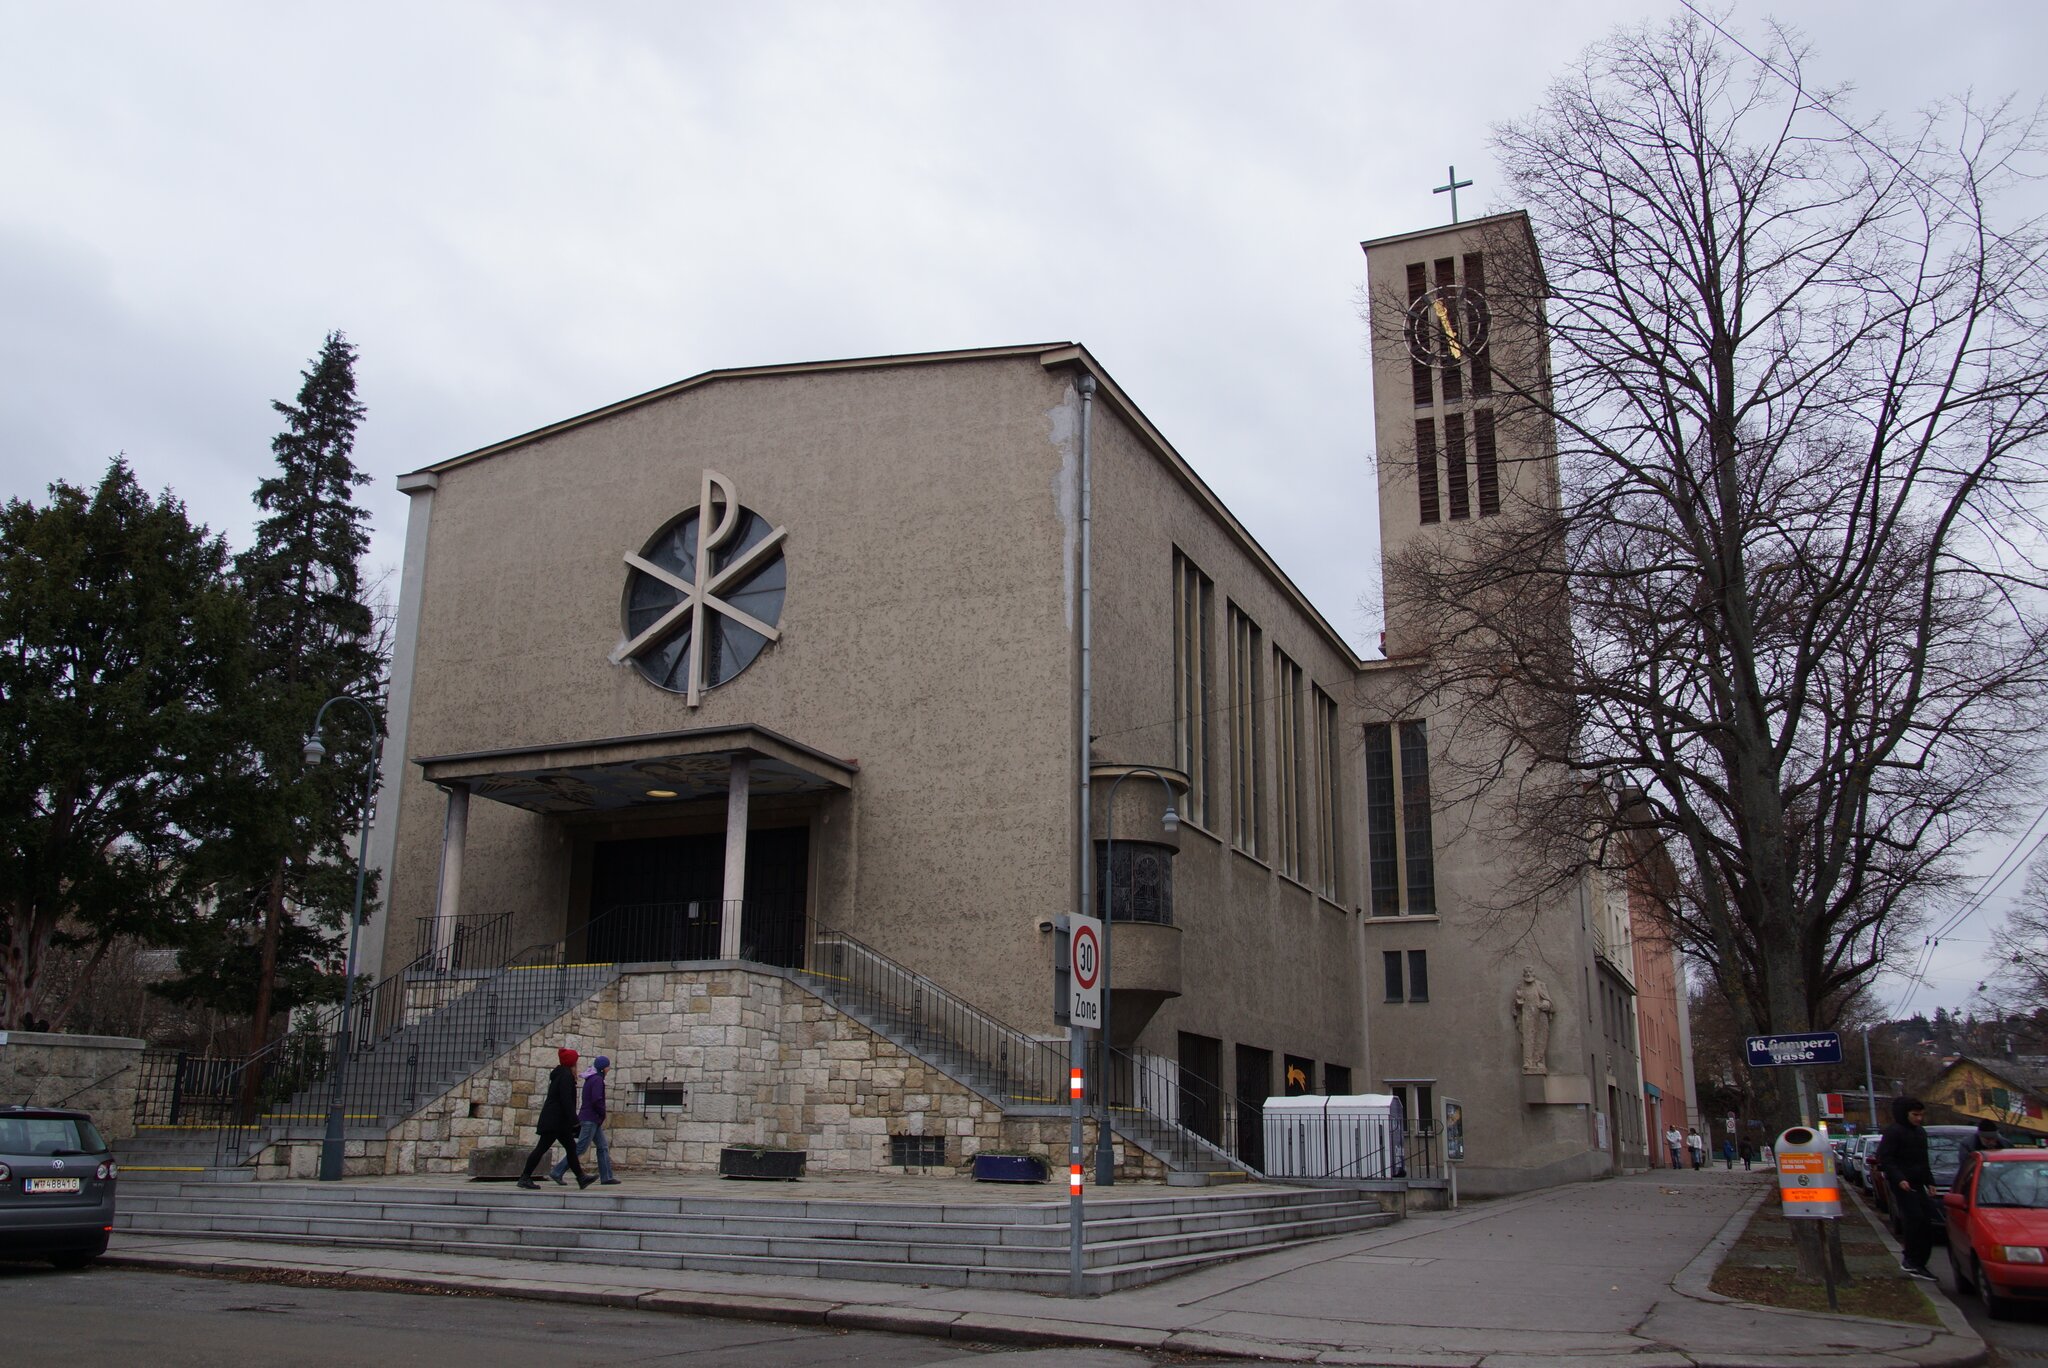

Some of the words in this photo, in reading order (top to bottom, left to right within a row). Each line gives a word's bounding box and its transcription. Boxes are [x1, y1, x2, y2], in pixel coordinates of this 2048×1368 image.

[1080, 943, 1092, 972] 30
[1075, 993, 1096, 1020] Zone
[1773, 1051, 1815, 1064] gasse
